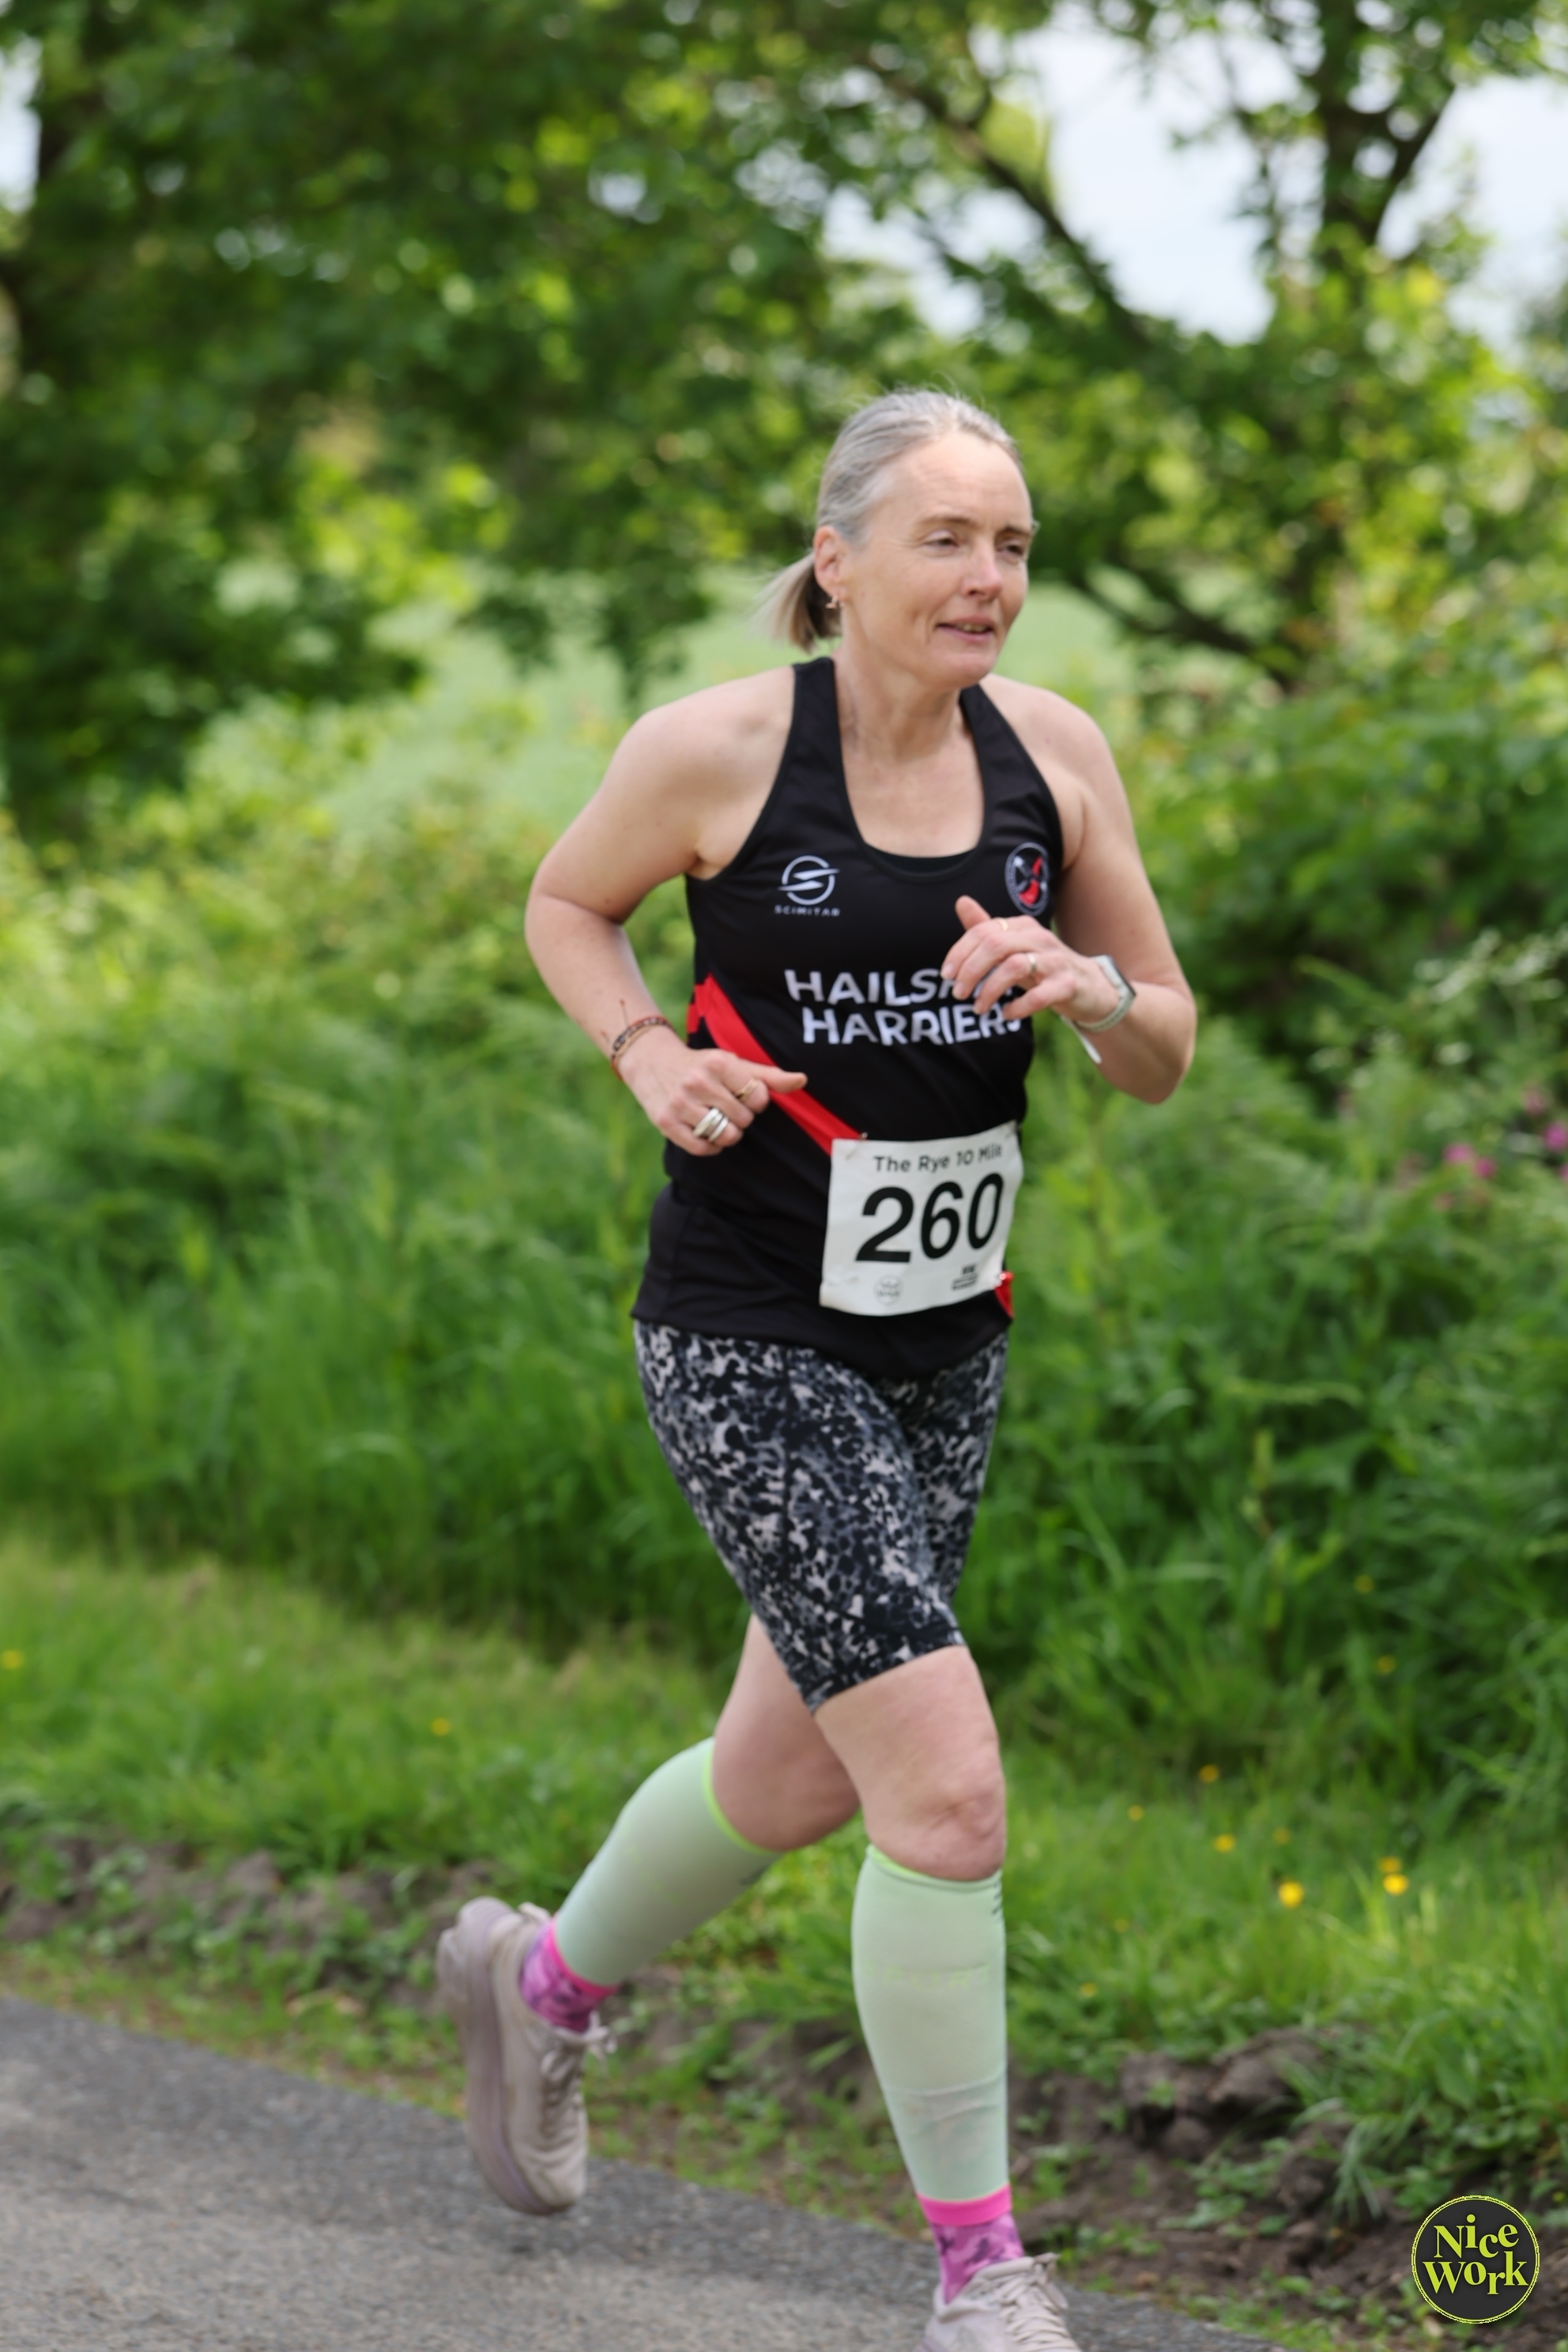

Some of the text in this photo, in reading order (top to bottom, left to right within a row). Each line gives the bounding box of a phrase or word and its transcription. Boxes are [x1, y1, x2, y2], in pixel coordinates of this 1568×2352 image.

[775, 904, 840, 917] SCIMITAR
[784, 968, 1012, 1006] HAILS
[873, 1143, 1002, 1174] The Rye 10 Mile
[854, 1172, 1004, 1264] 260
